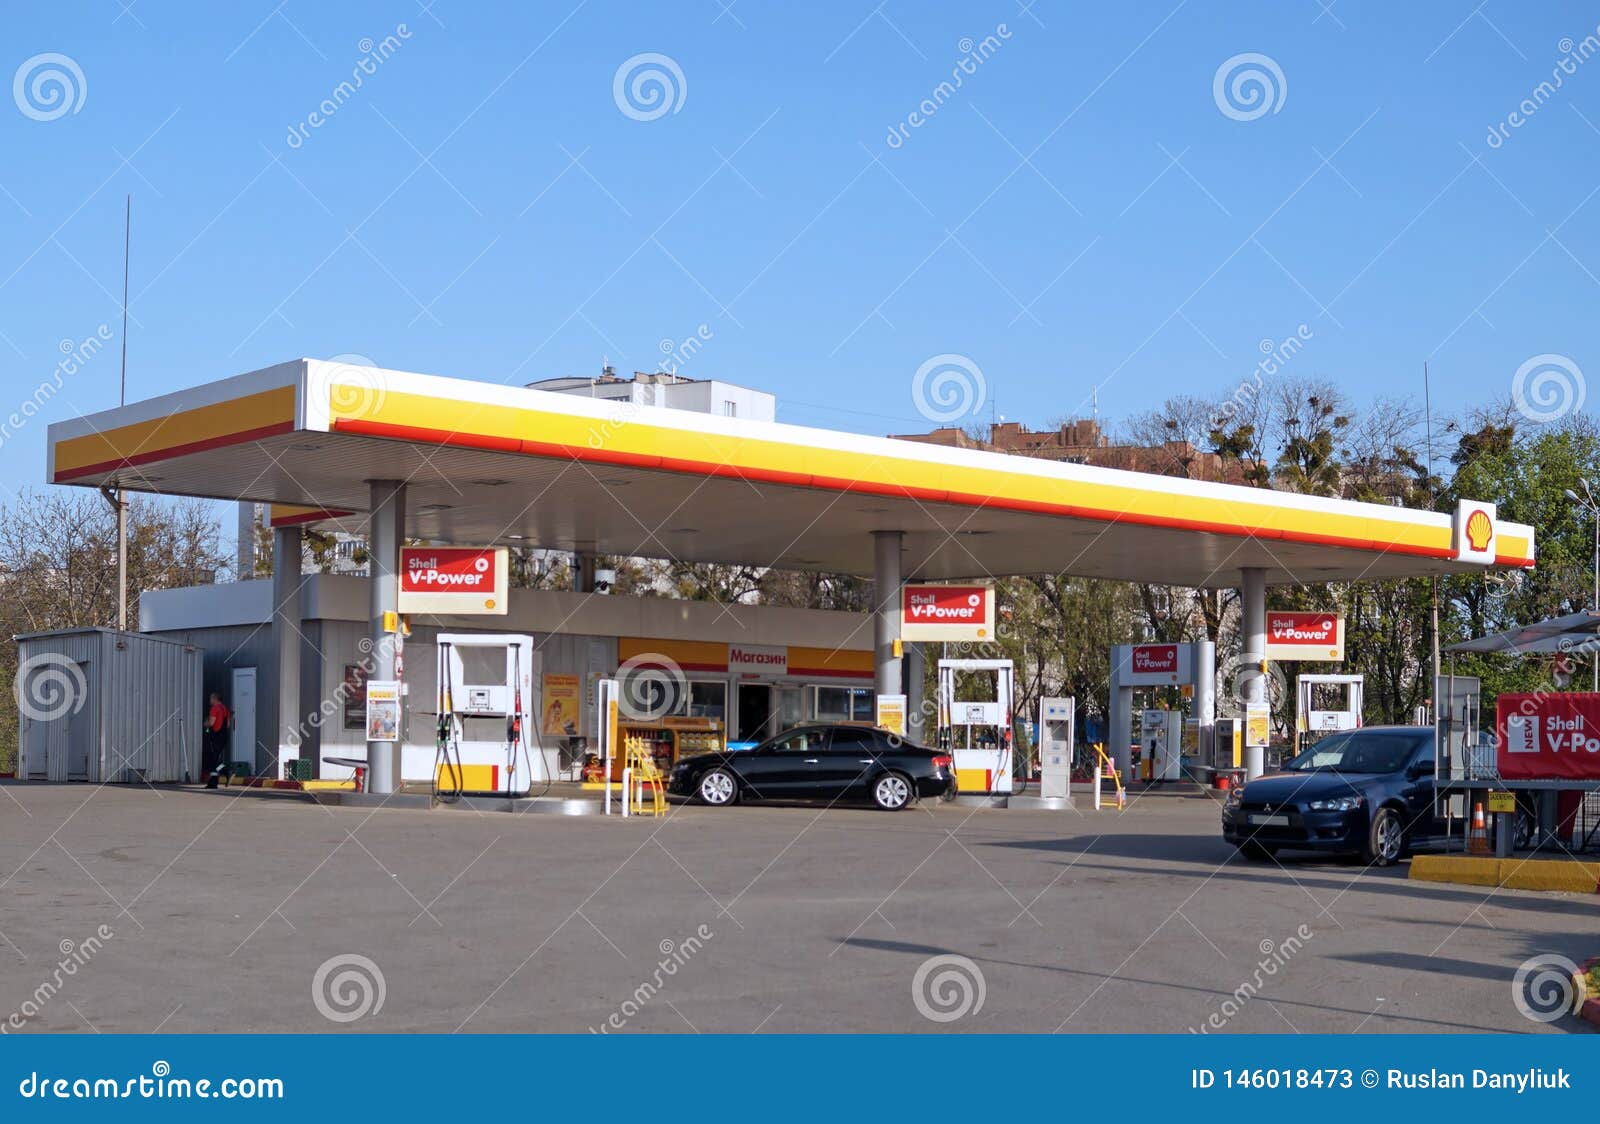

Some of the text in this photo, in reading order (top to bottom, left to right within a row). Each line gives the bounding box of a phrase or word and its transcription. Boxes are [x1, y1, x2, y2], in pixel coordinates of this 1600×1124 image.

[408, 557, 437, 569] Shell
[408, 569, 483, 585] V-Power
[910, 594, 935, 604] Shell
[910, 604, 975, 617] V-Power
[1272, 628, 1328, 640] V-Power
[730, 648, 786, 665] Магазин
[1546, 714, 1584, 731] Shell
[1524, 718, 1534, 750] NEW
